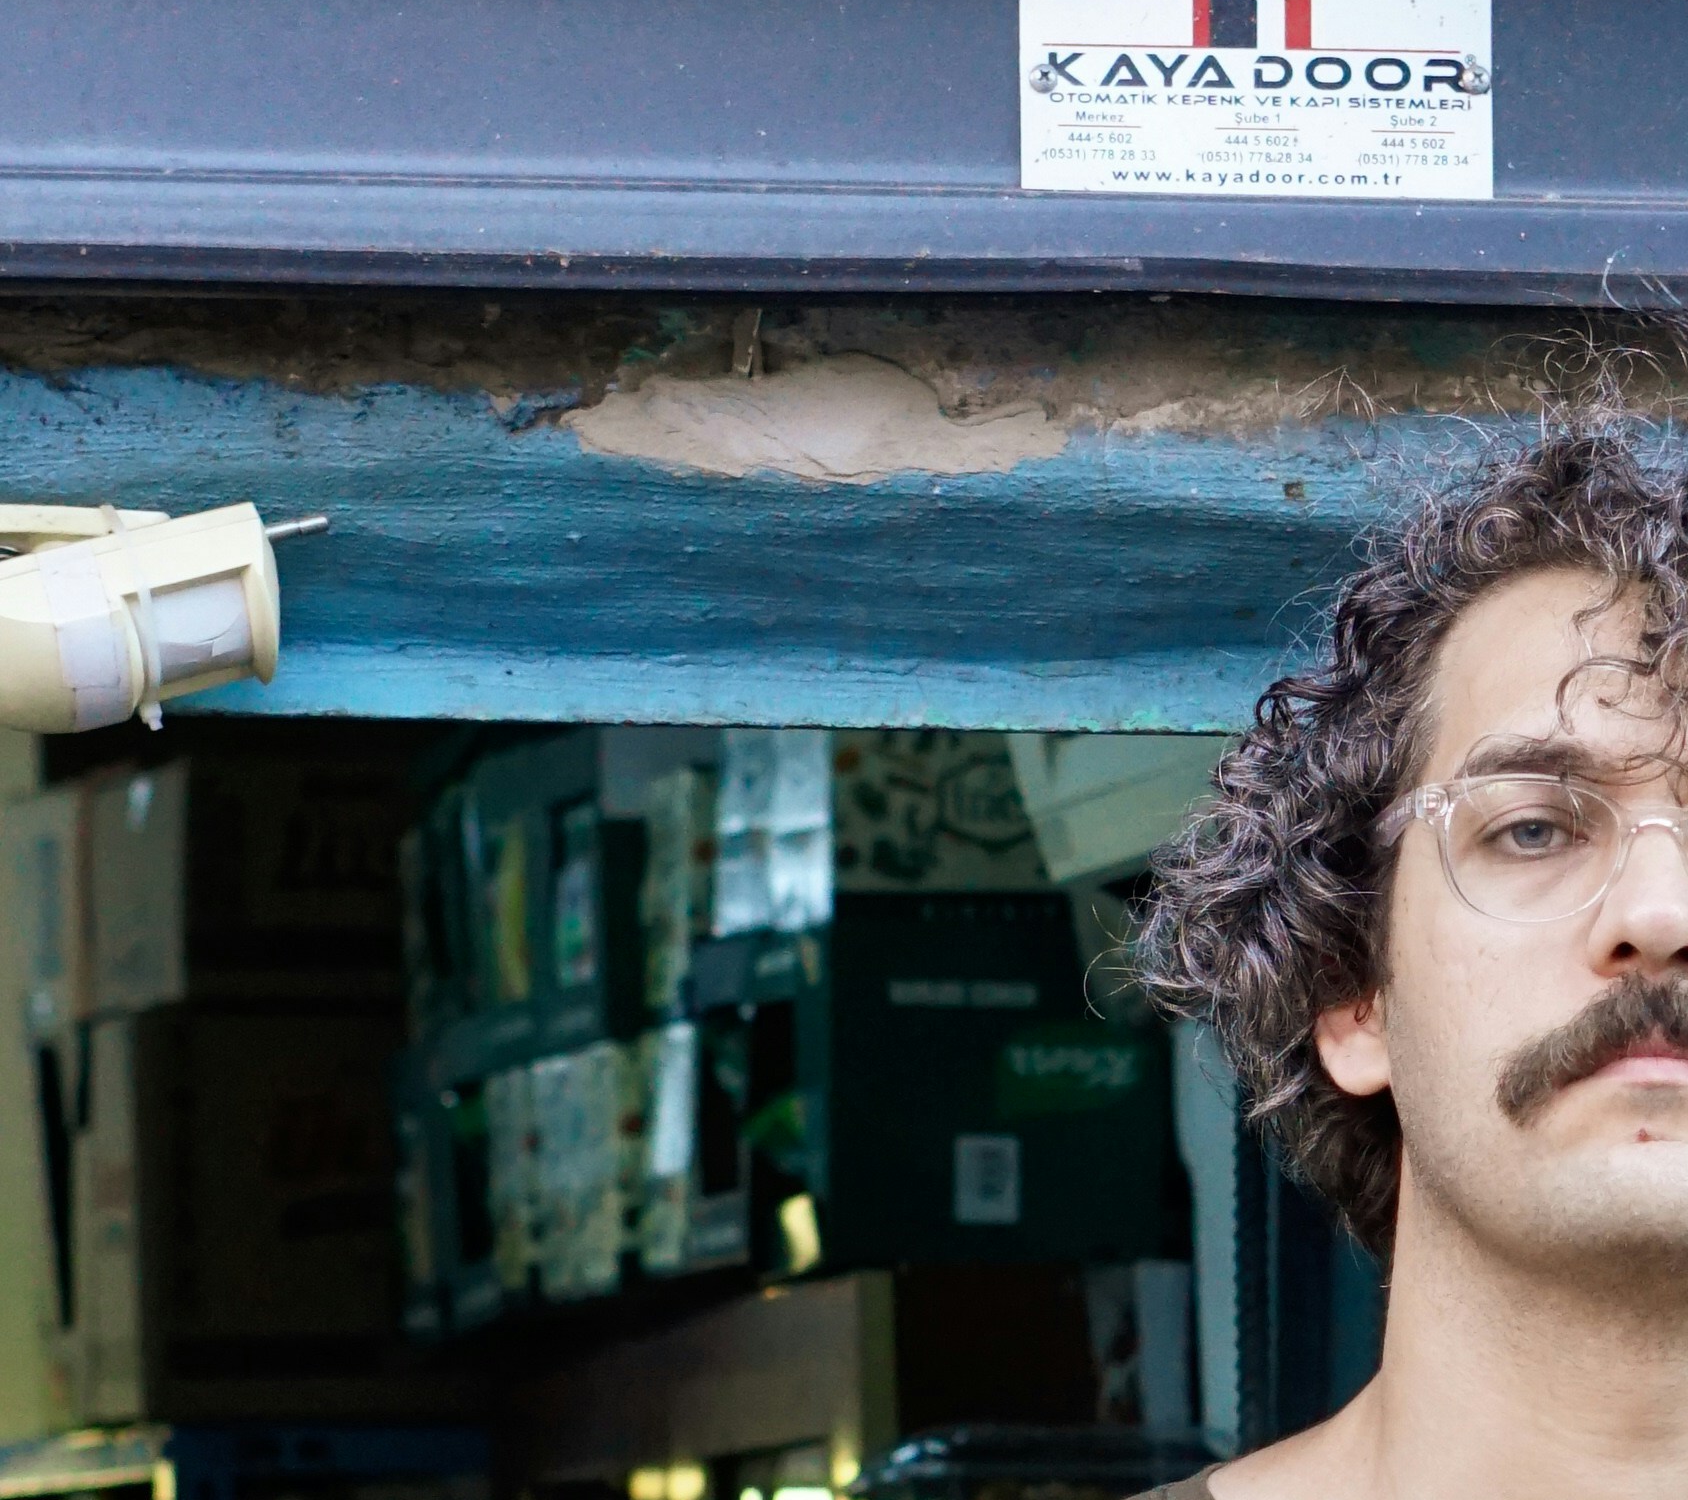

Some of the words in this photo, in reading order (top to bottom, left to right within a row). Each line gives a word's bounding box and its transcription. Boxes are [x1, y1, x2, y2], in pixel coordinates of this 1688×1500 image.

[1047, 52, 1236, 88] KAYA
[1253, 55, 1467, 93] DOOR
[1049, 90, 1158, 105] OTOMATİK
[1167, 93, 1246, 107] KEPENK
[1255, 95, 1283, 106] VE
[1290, 97, 1341, 108] KAPI
[1348, 94, 1473, 111] SİSTEMLERİ
[1075, 111, 1125, 123] Merkez
[1234, 112, 1271, 126] Şube
[1389, 115, 1425, 129] Şube
[1430, 116, 1438, 127] 2
[1067, 132, 1092, 143] 444
[1097, 132, 1104, 144] 5
[1109, 133, 1133, 144] 602
[1225, 135, 1249, 146] 444
[1253, 136, 1261, 146] 5
[1266, 136, 1289, 147] 602
[1381, 138, 1405, 149] 444
[1410, 138, 1418, 149] 5
[1422, 139, 1446, 150] 602
[1044, 148, 1087, 161] (0531)
[1092, 149, 1115, 161] 778
[1120, 150, 1136, 161] 28
[1141, 150, 1157, 161] 33
[1201, 151, 1244, 164] (0531)
[1277, 152, 1292, 163] 28
[1298, 152, 1313, 164] 34
[1358, 154, 1401, 167] (0531)
[1405, 154, 1428, 166] 778
[1433, 155, 1449, 166] 28
[1454, 155, 1470, 166] 34
[1112, 169, 1404, 187] www.kayadoor.com.tr
